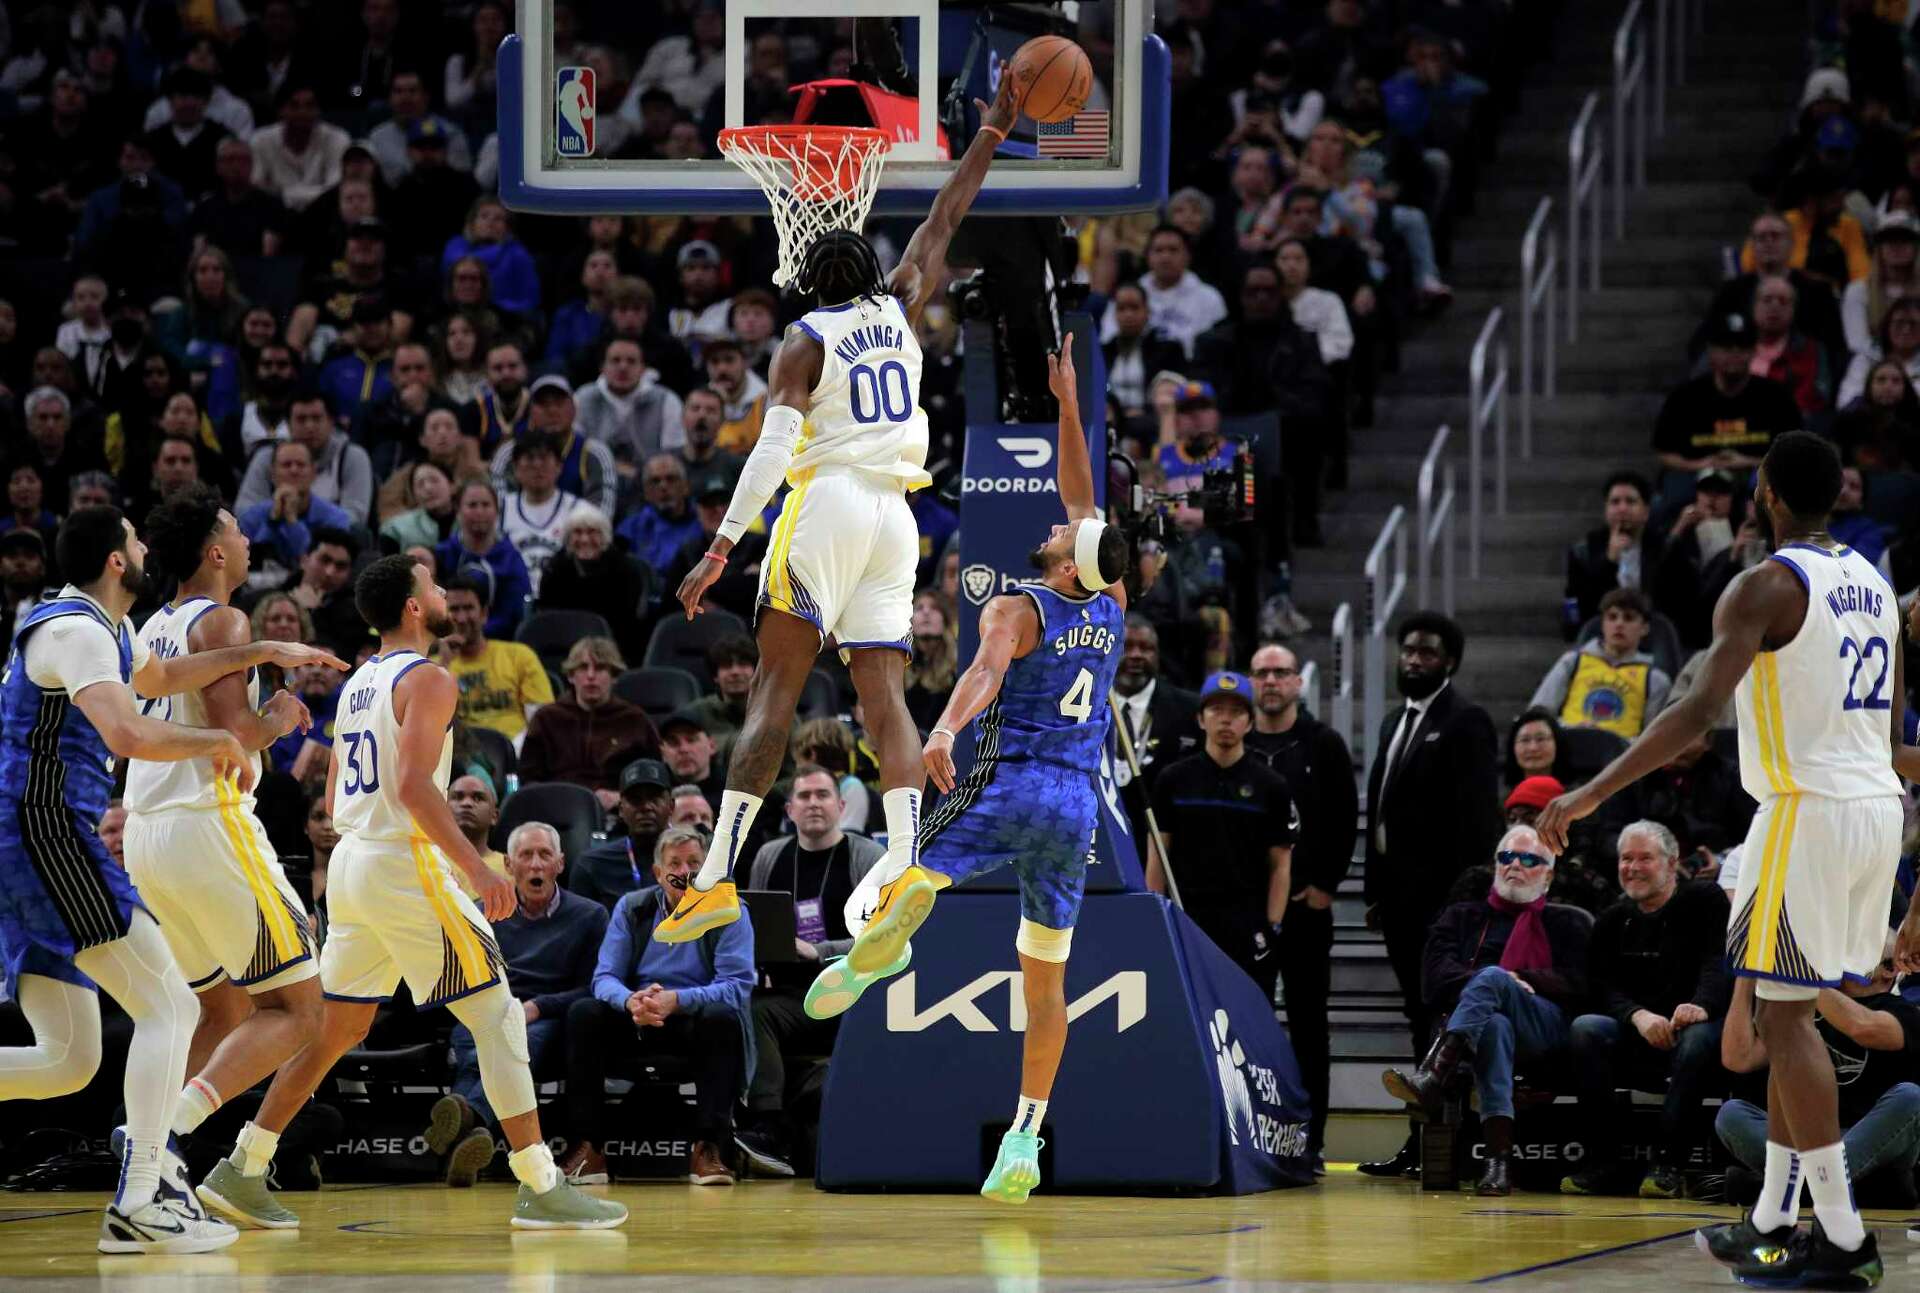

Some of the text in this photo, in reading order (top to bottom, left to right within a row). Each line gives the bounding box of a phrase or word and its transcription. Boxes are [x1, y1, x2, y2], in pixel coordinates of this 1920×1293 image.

[562, 136, 580, 150] NBA
[834, 325, 903, 365] KUMINGA
[849, 361, 912, 424] 00
[962, 477, 1057, 493] DOORDA
[1826, 585, 1882, 618] WGGINS
[1055, 625, 1115, 656] SUGGS
[1839, 636, 1891, 711] 22
[1060, 667, 1094, 724] 4
[342, 729, 380, 796] 30
[604, 1140, 687, 1157] CHASE
[1471, 1143, 1558, 1160] CASE
